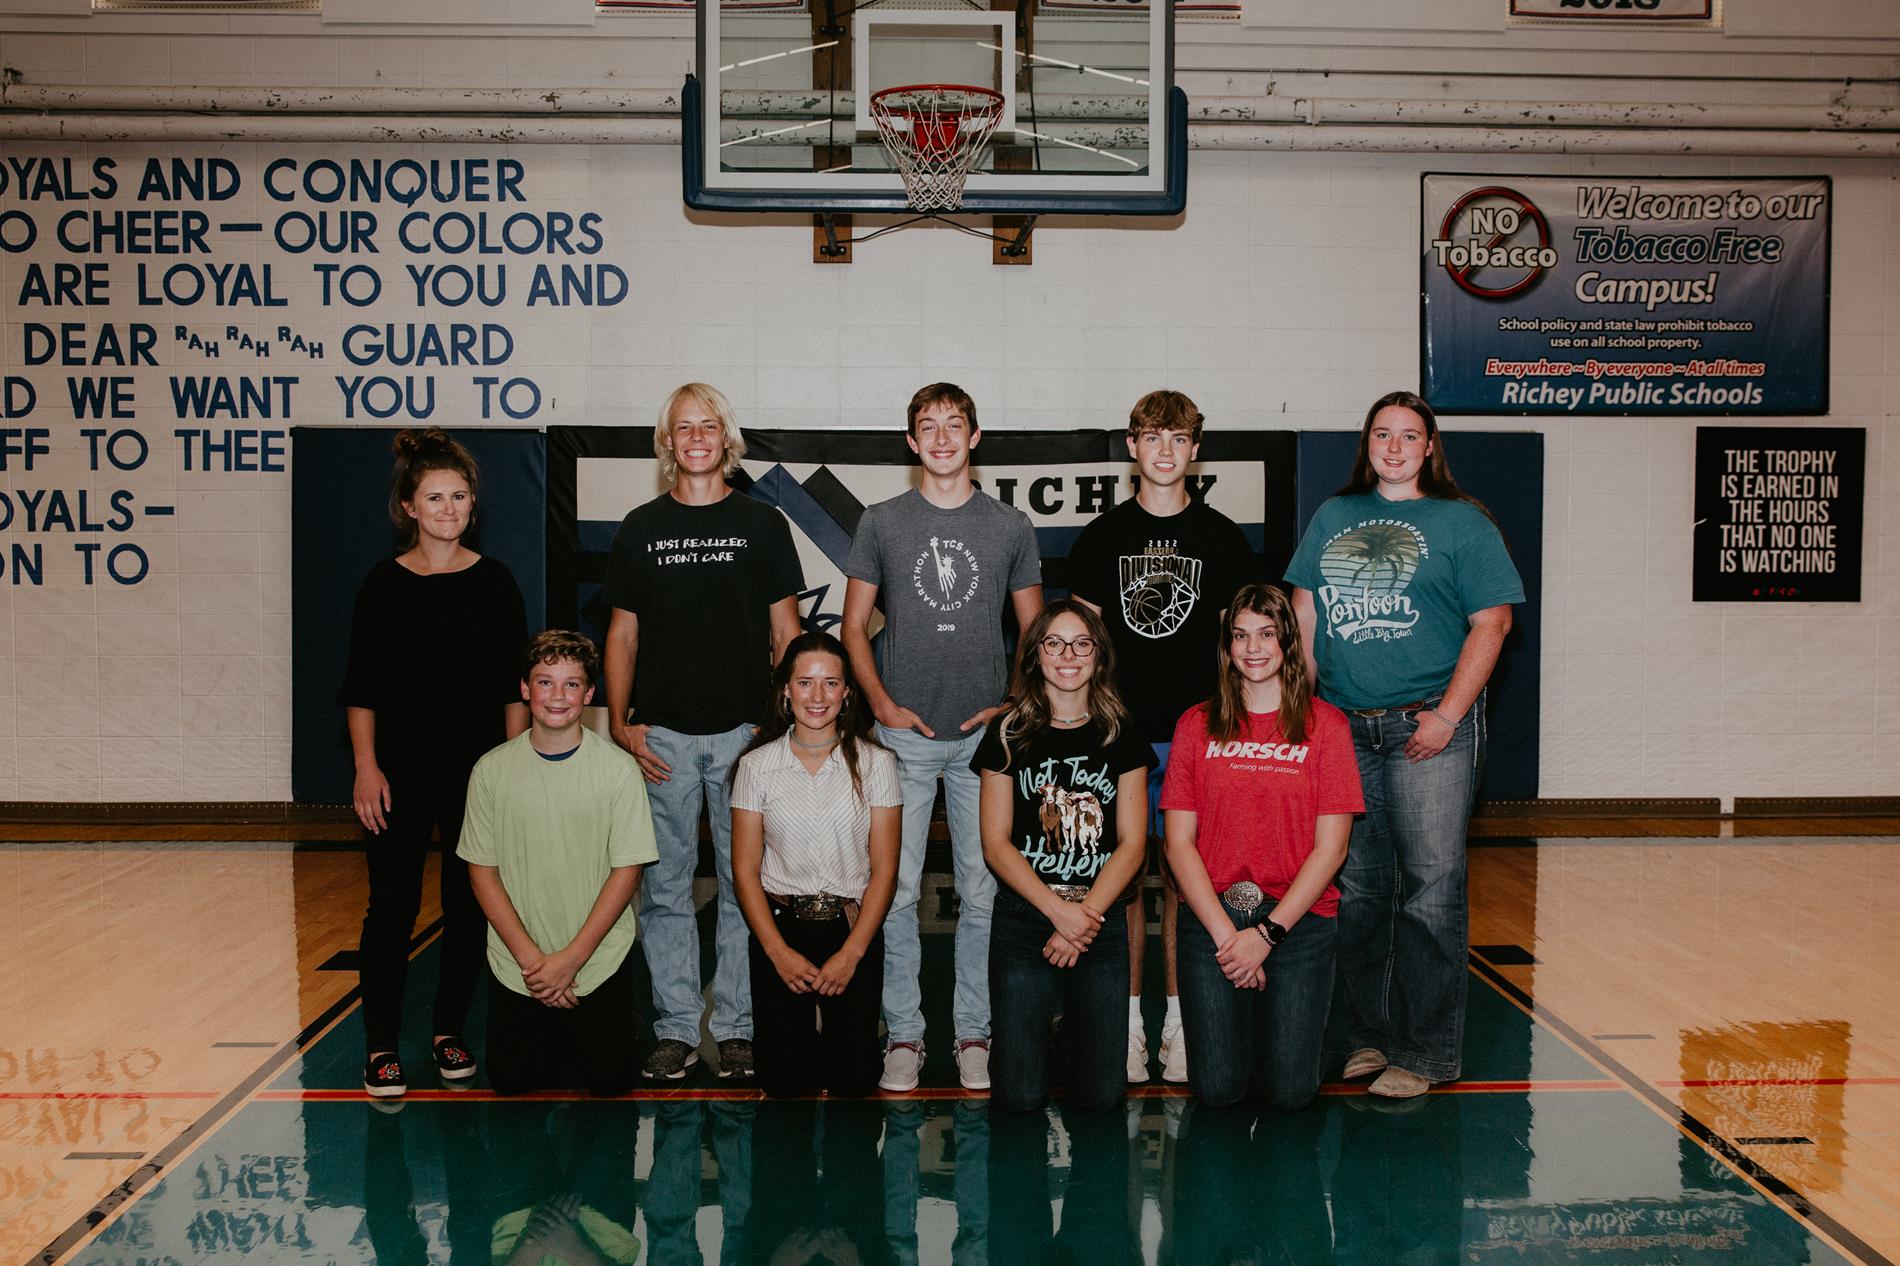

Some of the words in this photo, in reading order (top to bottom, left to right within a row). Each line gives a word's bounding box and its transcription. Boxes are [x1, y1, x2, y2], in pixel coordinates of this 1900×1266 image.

[0, 157, 118, 201] YALS
[137, 157, 241, 201] AND
[263, 158, 527, 208] CONQUER
[1576, 186, 1723, 220] Welcome
[1725, 189, 1761, 220] to
[1765, 194, 1825, 221] our
[398, 211, 604, 255] COLORS
[1471, 207, 1520, 235] NO
[1432, 239, 1559, 269] Tobacco
[1574, 225, 1708, 264] Tobacco
[1708, 227, 1784, 264] Free
[18, 263, 110, 306] ARE
[137, 263, 288, 307] LOYAL
[313, 264, 382, 307] TO
[406, 264, 506, 307] YOU
[526, 264, 629, 307] AND
[1574, 271, 1719, 312] Campus!
[1499, 318, 1539, 331] School
[1541, 319, 1578, 333] policy
[1579, 319, 1602, 331] and
[1604, 320, 1633, 331] state
[1634, 319, 1655, 331] law
[1657, 320, 1705, 333] prohibit
[1706, 320, 1753, 331] tobacco
[23, 322, 160, 366] DEAR
[175, 325, 220, 358] RAH
[226, 325, 270, 358] RAH
[277, 326, 324, 359] RAH
[342, 323, 514, 367] GUARD
[1550, 337, 1571, 348] use
[1573, 338, 1589, 348] on
[1590, 336, 1605, 348] all
[1607, 336, 1646, 348] school
[1647, 337, 1702, 350] property.
[1485, 358, 1573, 379] Everywhere
[1584, 359, 1606, 380] By
[1606, 361, 1674, 380] everyone
[1685, 359, 1706, 376] At
[1705, 359, 1726, 376] all
[1725, 359, 1765, 376] times
[0, 376, 37, 419] D
[67, 376, 136, 419] WE
[169, 376, 300, 419] WANT
[335, 376, 435, 419] YOU
[473, 377, 542, 419] TO
[1502, 381, 1585, 410] Richey
[1588, 382, 1665, 405] Public
[1668, 382, 1764, 405] Schools
[80, 428, 149, 471] TO
[174, 430, 286, 472] THEE
[1724, 450, 1760, 473] THE
[1764, 450, 1837, 473] TROPHY
[969, 474, 1217, 516] ICHY
[1721, 475, 1739, 498] IS
[1743, 475, 1815, 498] EARNED
[1820, 475, 1839, 498] IN
[1729, 500, 1764, 523] THE
[1769, 500, 1830, 523] HOURS
[647, 543, 652, 552] I
[655, 539, 680, 551] JUST
[682, 537, 748, 549] REALIZED.
[942, 539, 964, 551] TCS
[1148, 539, 1178, 548] 2022
[1720, 525, 1767, 548] THAT
[1771, 525, 1796, 548] NO
[1800, 525, 1837, 548] ONE
[0, 543, 43, 585] N
[74, 543, 150, 585] TO
[657, 556, 662, 566] I
[665, 552, 698, 565] DON'T
[701, 551, 735, 562] CARE
[963, 549, 980, 572] NEW
[1720, 549, 1737, 573] IS
[1741, 550, 1836, 573] WATCHING
[913, 550, 938, 609] MARATHON
[962, 575, 980, 603] YORK
[1119, 555, 1203, 600] DIVISIONAL
[940, 600, 962, 612] CITY
[1318, 584, 1420, 640] Pontoon
[937, 624, 956, 632] 2019
[1353, 627, 1375, 645] Little
[1375, 627, 1393, 642] Big
[1393, 628, 1413, 639] Town
[1205, 741, 1309, 764] HORSCH
[1018, 757, 1060, 800] Not
[1063, 755, 1117, 805] Today
[1229, 762, 1257, 772] Farming
[1274, 766, 1300, 775] passion
